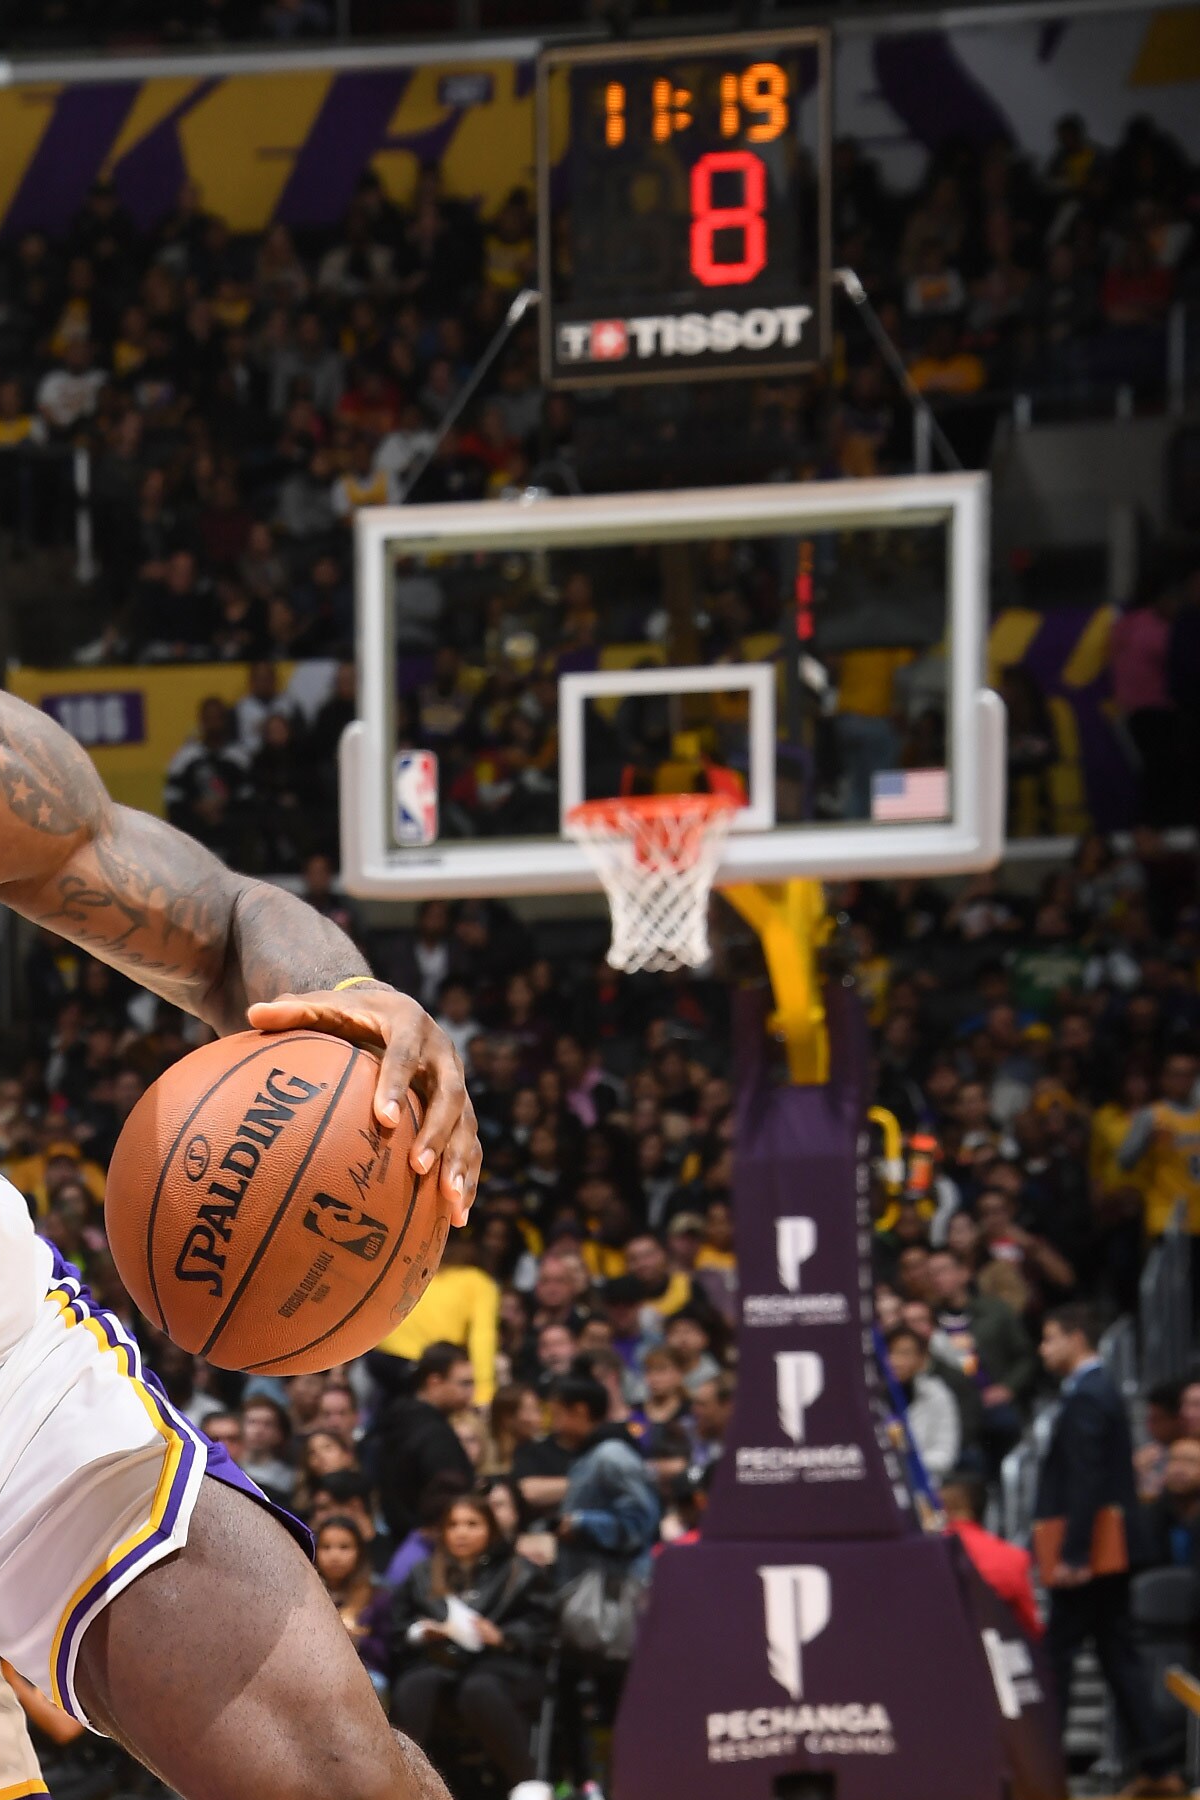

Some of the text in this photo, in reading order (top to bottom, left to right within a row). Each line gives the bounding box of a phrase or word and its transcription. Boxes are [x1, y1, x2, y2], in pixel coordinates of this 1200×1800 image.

[690, 150, 767, 287] 8
[628, 304, 812, 359] TISSOT
[174, 1068, 323, 1298] SPALDING
[706, 1703, 892, 1742] PECHANGA
